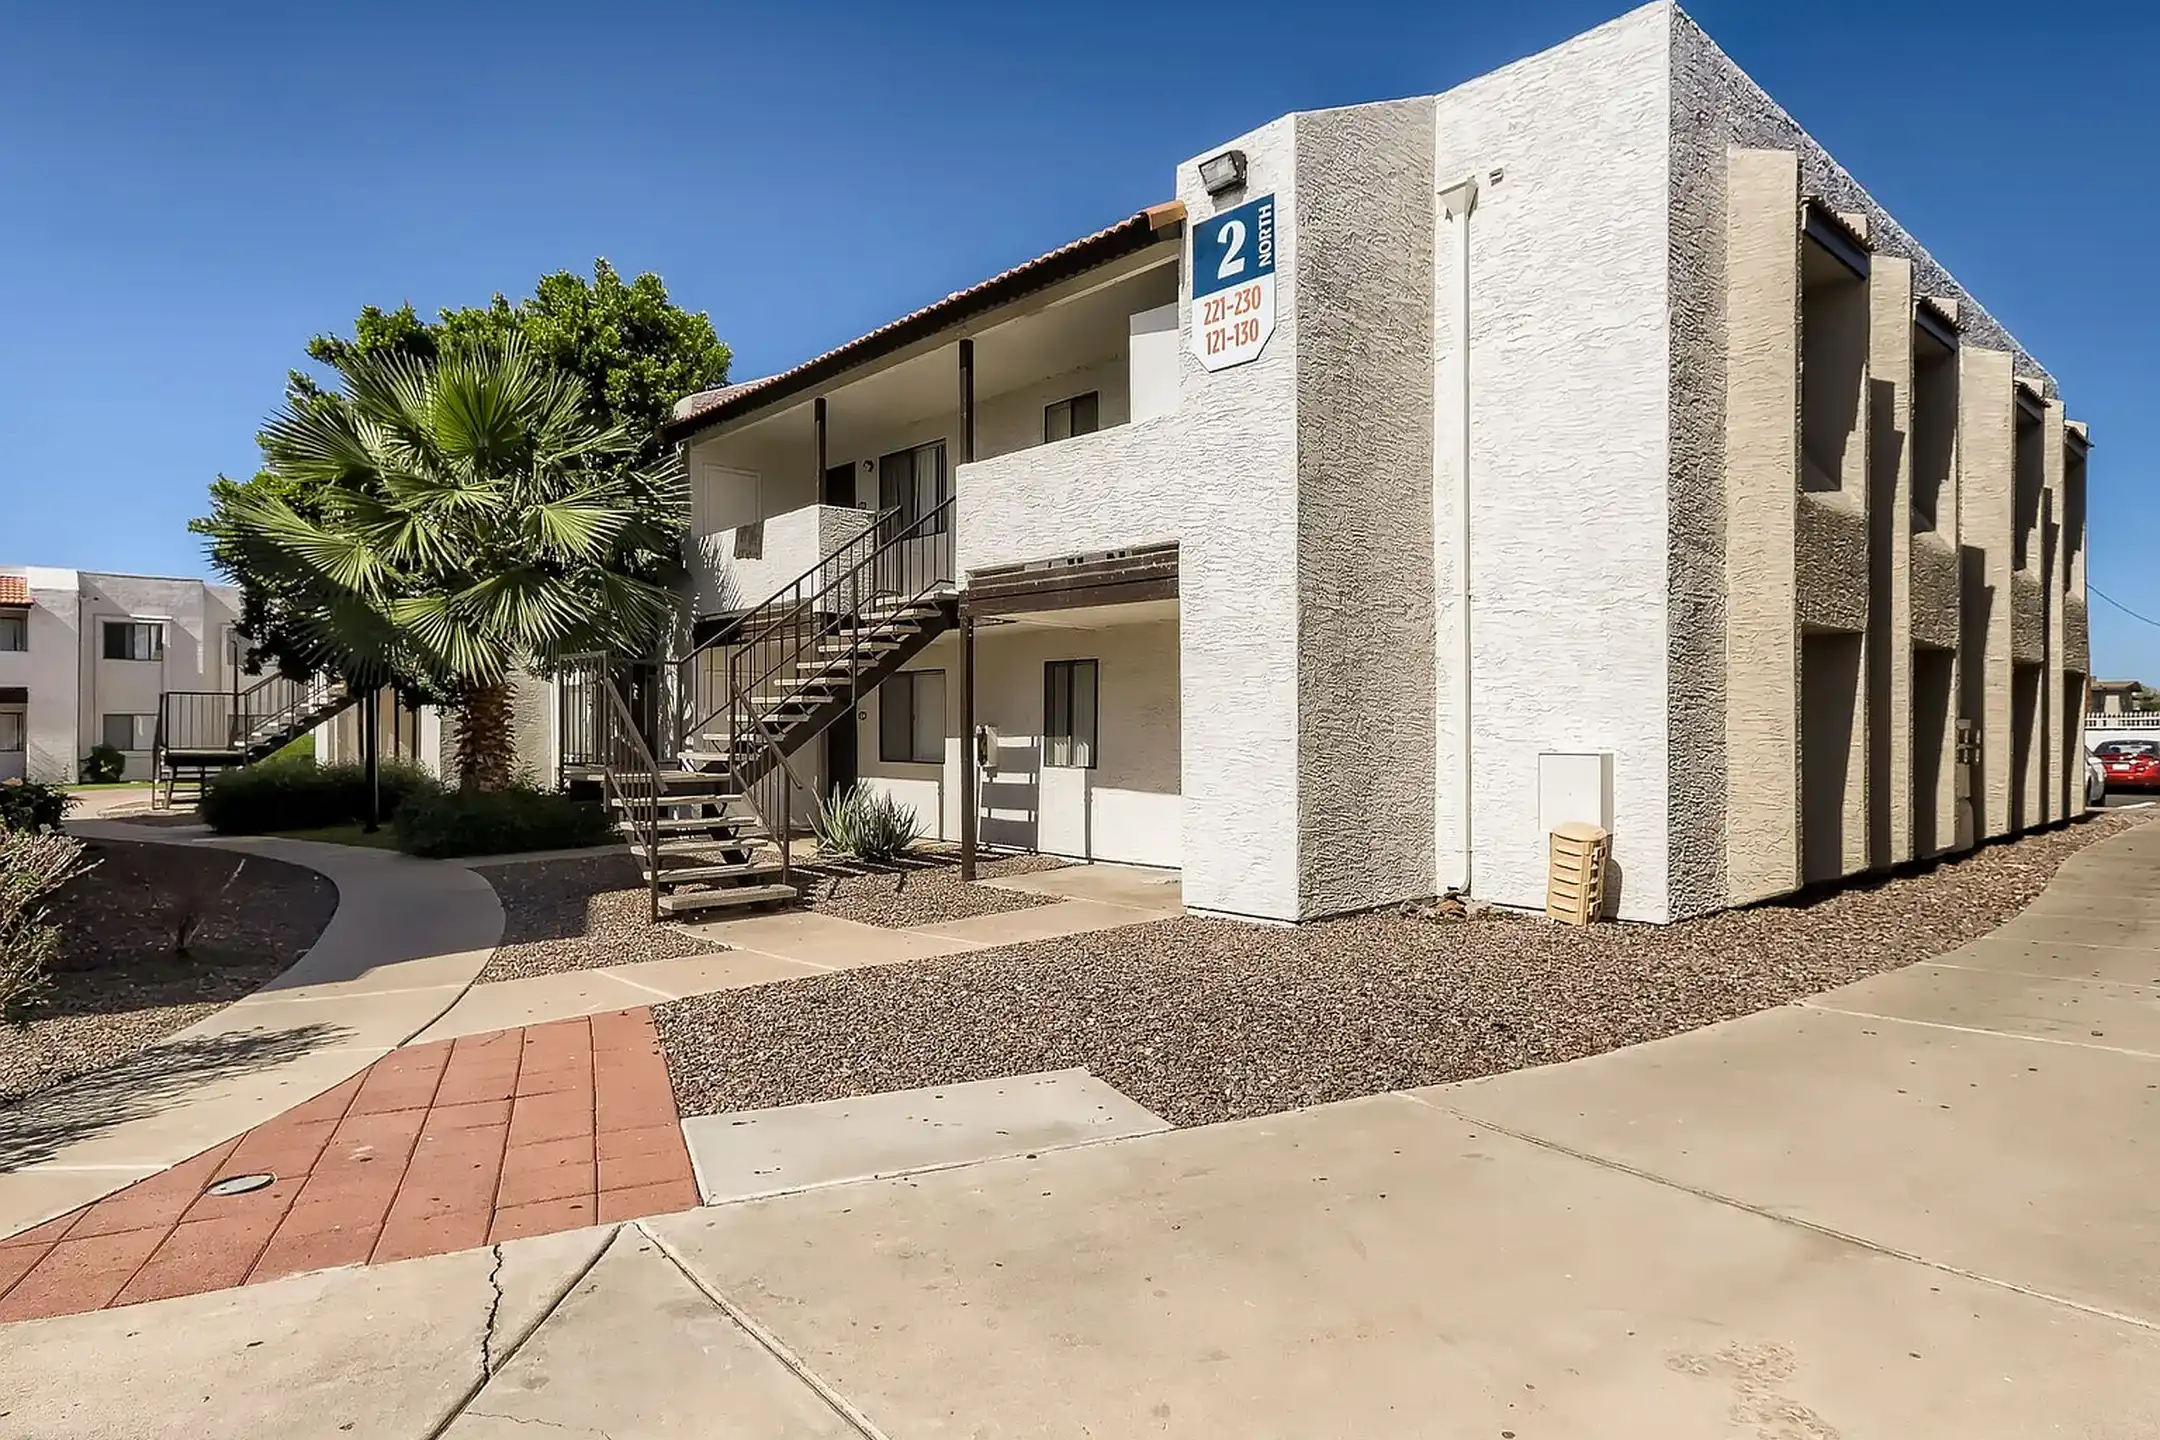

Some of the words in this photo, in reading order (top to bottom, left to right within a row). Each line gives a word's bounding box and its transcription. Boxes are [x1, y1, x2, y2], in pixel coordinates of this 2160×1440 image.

[1217, 220, 1246, 280] 2
[1258, 203, 1272, 268] NORTH
[1203, 284, 1261, 326] 221-230
[1205, 317, 1259, 355] 121-130
